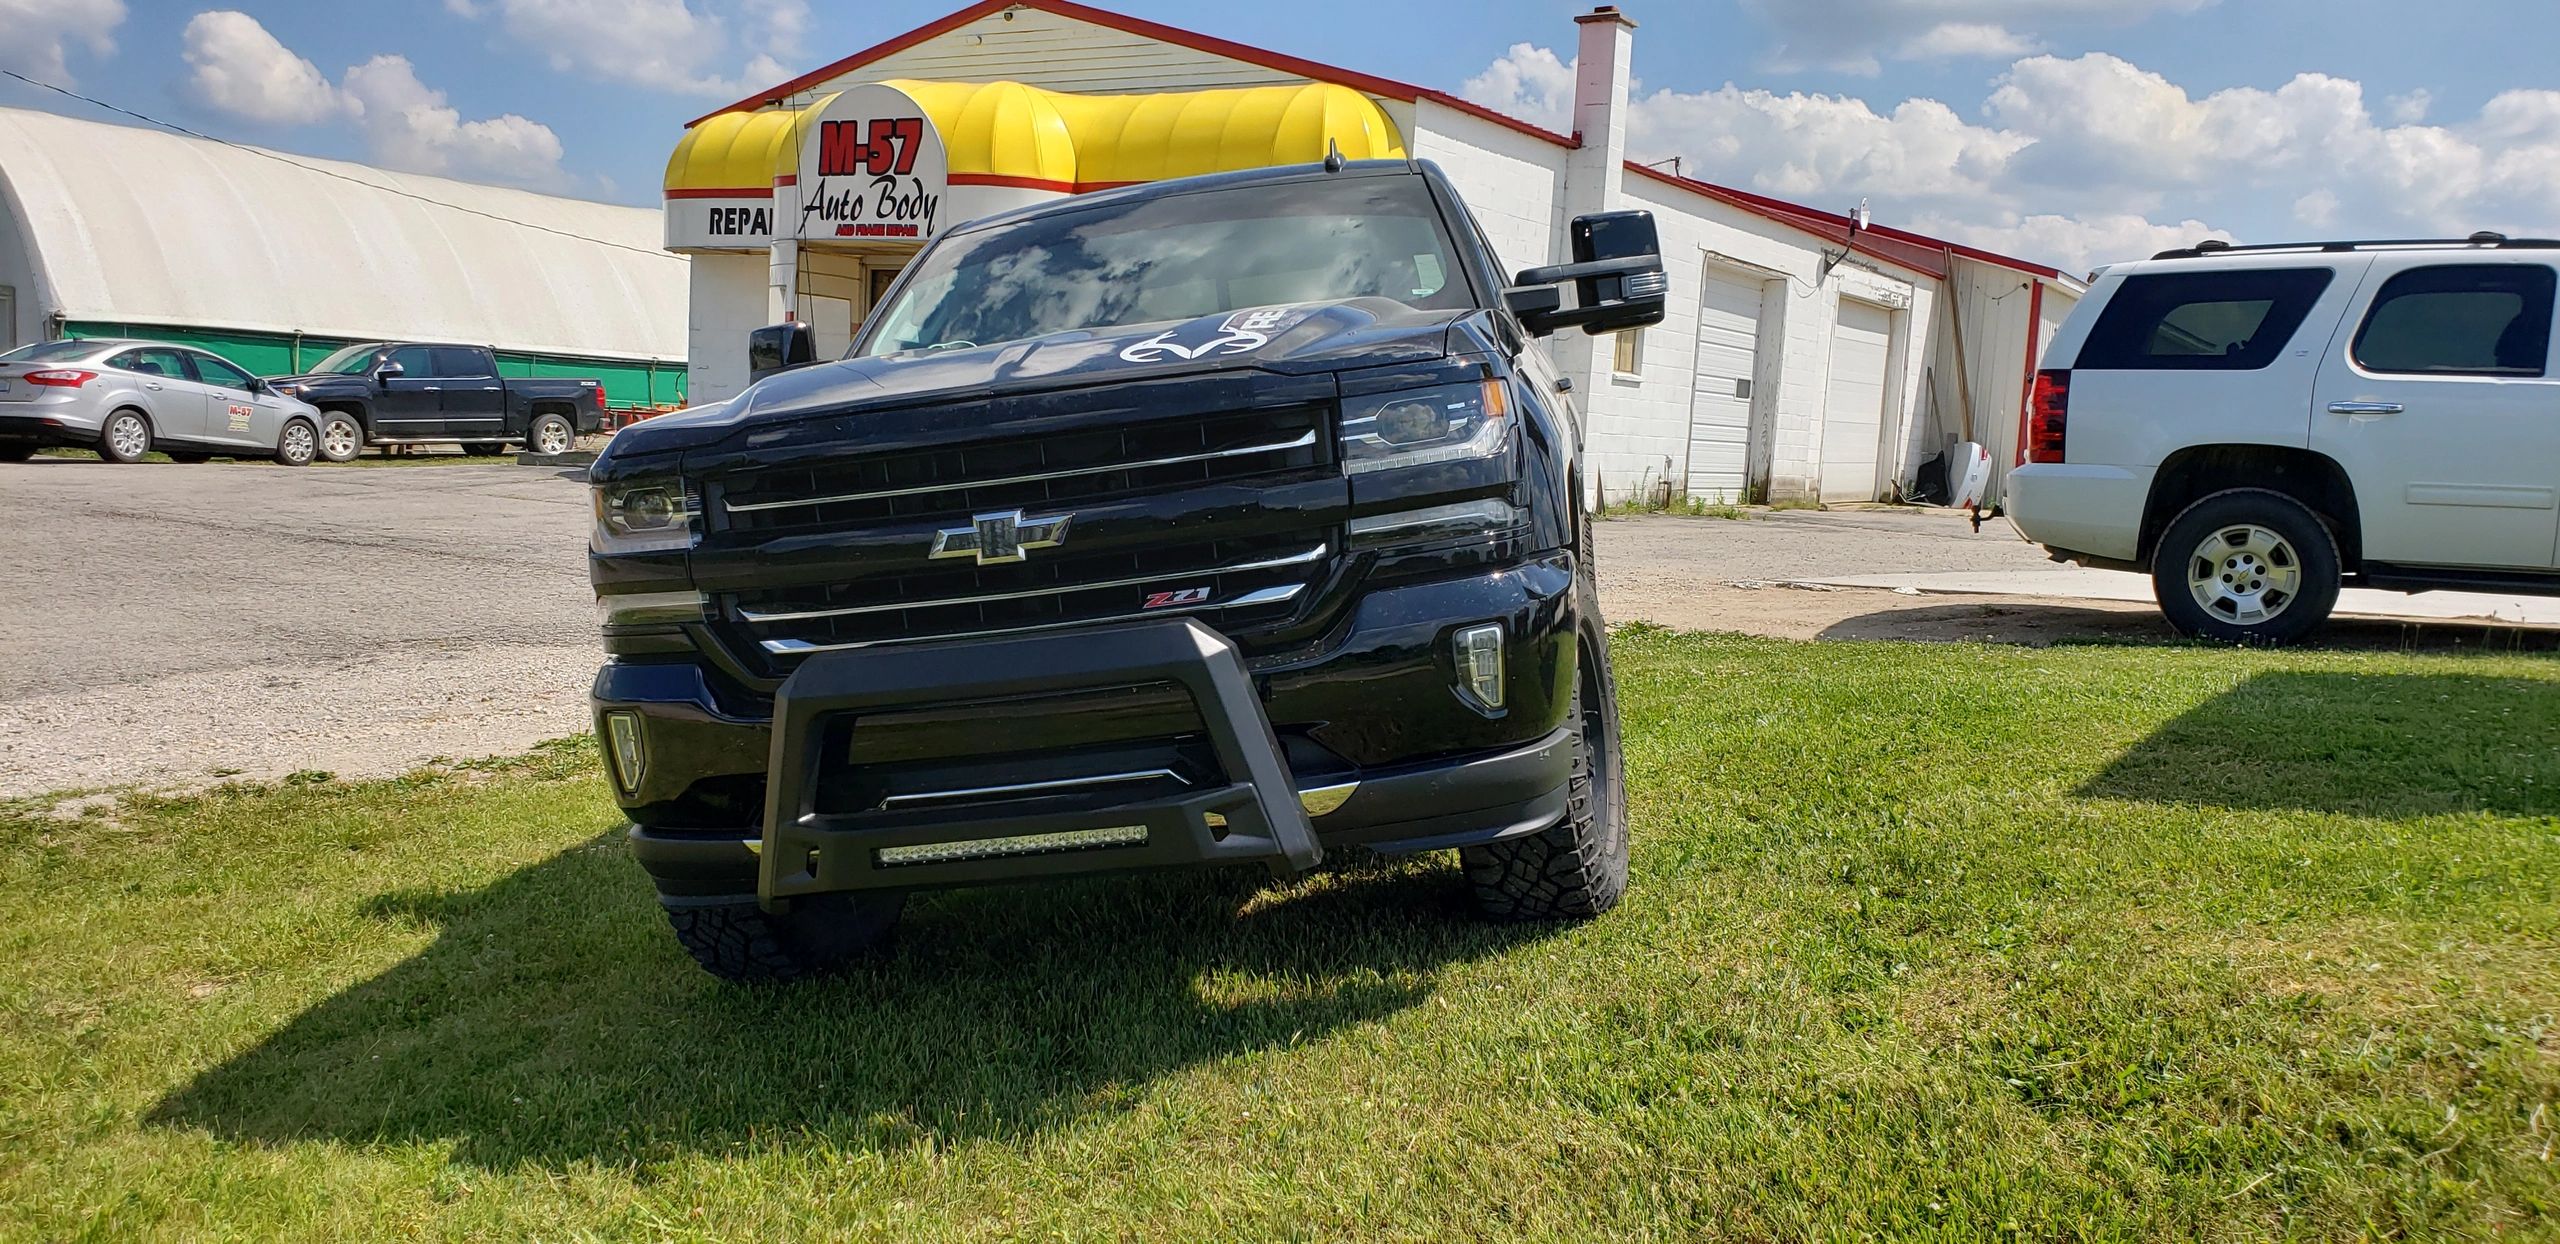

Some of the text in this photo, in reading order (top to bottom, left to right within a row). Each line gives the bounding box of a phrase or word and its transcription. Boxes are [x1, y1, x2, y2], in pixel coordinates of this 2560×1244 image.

[818, 118, 923, 176] M-57
[798, 174, 938, 237] Auto Body
[835, 223, 919, 237] AND FRAME REPAIR
[229, 404, 253, 417] M-57
[1143, 586, 1211, 609] Z71
